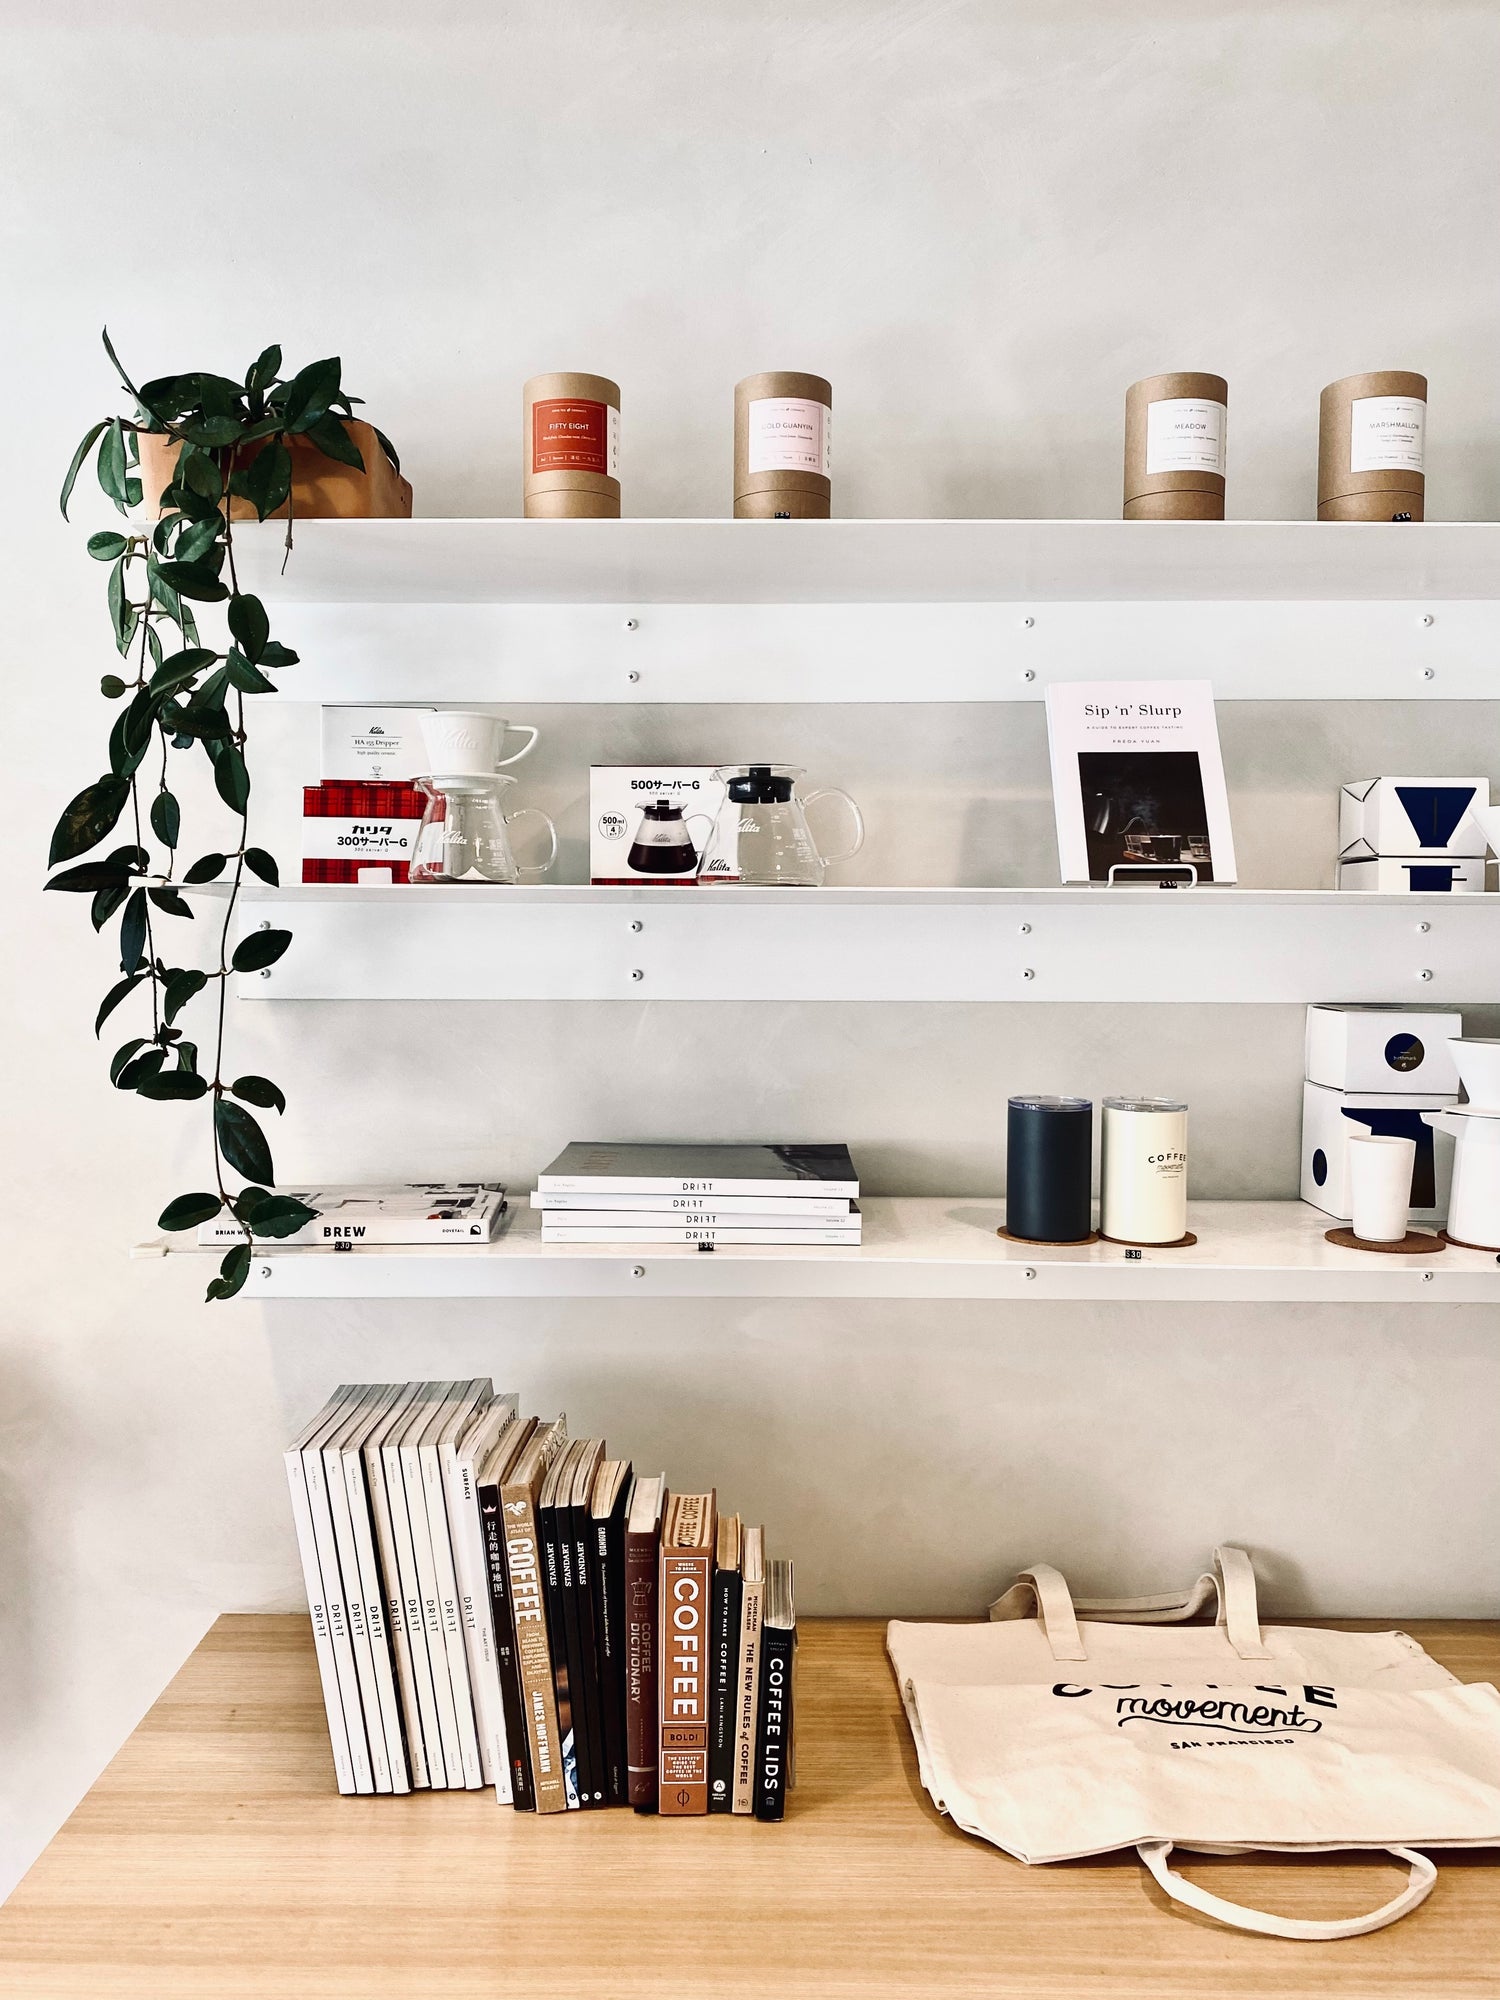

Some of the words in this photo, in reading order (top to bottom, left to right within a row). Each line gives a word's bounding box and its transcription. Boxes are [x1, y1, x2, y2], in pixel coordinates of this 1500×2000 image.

[782, 422, 813, 430] GUANYIN
[1084, 704, 1110, 718] Sip
[1138, 704, 1182, 718] Slurp
[376, 739, 399, 747] Dripper
[631, 780, 700, 790] 500サーバーG
[337, 836, 408, 847] 300サーバーG
[351, 825, 393, 835] カリタ
[438, 830, 468, 845] Kalita
[706, 858, 731, 872] Kalita
[1148, 1153, 1186, 1163] COFFEE
[682, 1182, 713, 1191] DRIFT
[673, 1199, 703, 1208] DRIFT
[686, 1215, 717, 1223] DRIFT
[323, 1226, 366, 1237] BREW
[685, 1231, 716, 1239] DRIFT
[462, 1468, 471, 1500] SURFACE
[487, 1521, 503, 1593] 行走的咖啡地图
[546, 1542, 557, 1586] STANDART
[561, 1543, 572, 1587] STANDART
[576, 1541, 587, 1585] STANDART
[507, 1537, 542, 1625] COFFEE
[314, 1605, 326, 1637] DRIFT
[331, 1604, 344, 1636] DRIFT
[351, 1603, 364, 1636] DRIFT
[370, 1606, 382, 1638] DRIFT
[390, 1599, 402, 1632] DRIFT
[408, 1599, 421, 1632] DRIFT
[426, 1599, 439, 1632] DRIFT
[444, 1600, 457, 1632] DRIFT
[463, 1596, 476, 1628] DRIFT
[722, 1606, 729, 1616] TO
[641, 1622, 651, 1673] COFFEE
[673, 1577, 699, 1715] COFFEE
[746, 1642, 754, 1663] THE
[630, 1622, 640, 1704] DICTIONARY
[719, 1642, 728, 1684] COFFEE
[744, 1667, 753, 1691] NEW
[532, 1690, 546, 1721] JAMES
[742, 1695, 752, 1729] RULES
[767, 1658, 784, 1735] COFFEE
[1116, 1697, 1322, 1732] movement
[536, 1723, 551, 1773] HOFFMANN
[739, 1731, 749, 1741] of
[1170, 1741, 1202, 1750] SAN
[1206, 1738, 1295, 1747] FRANCISCO
[740, 1744, 749, 1784] COFFEE
[764, 1745, 780, 1790] LIDS
